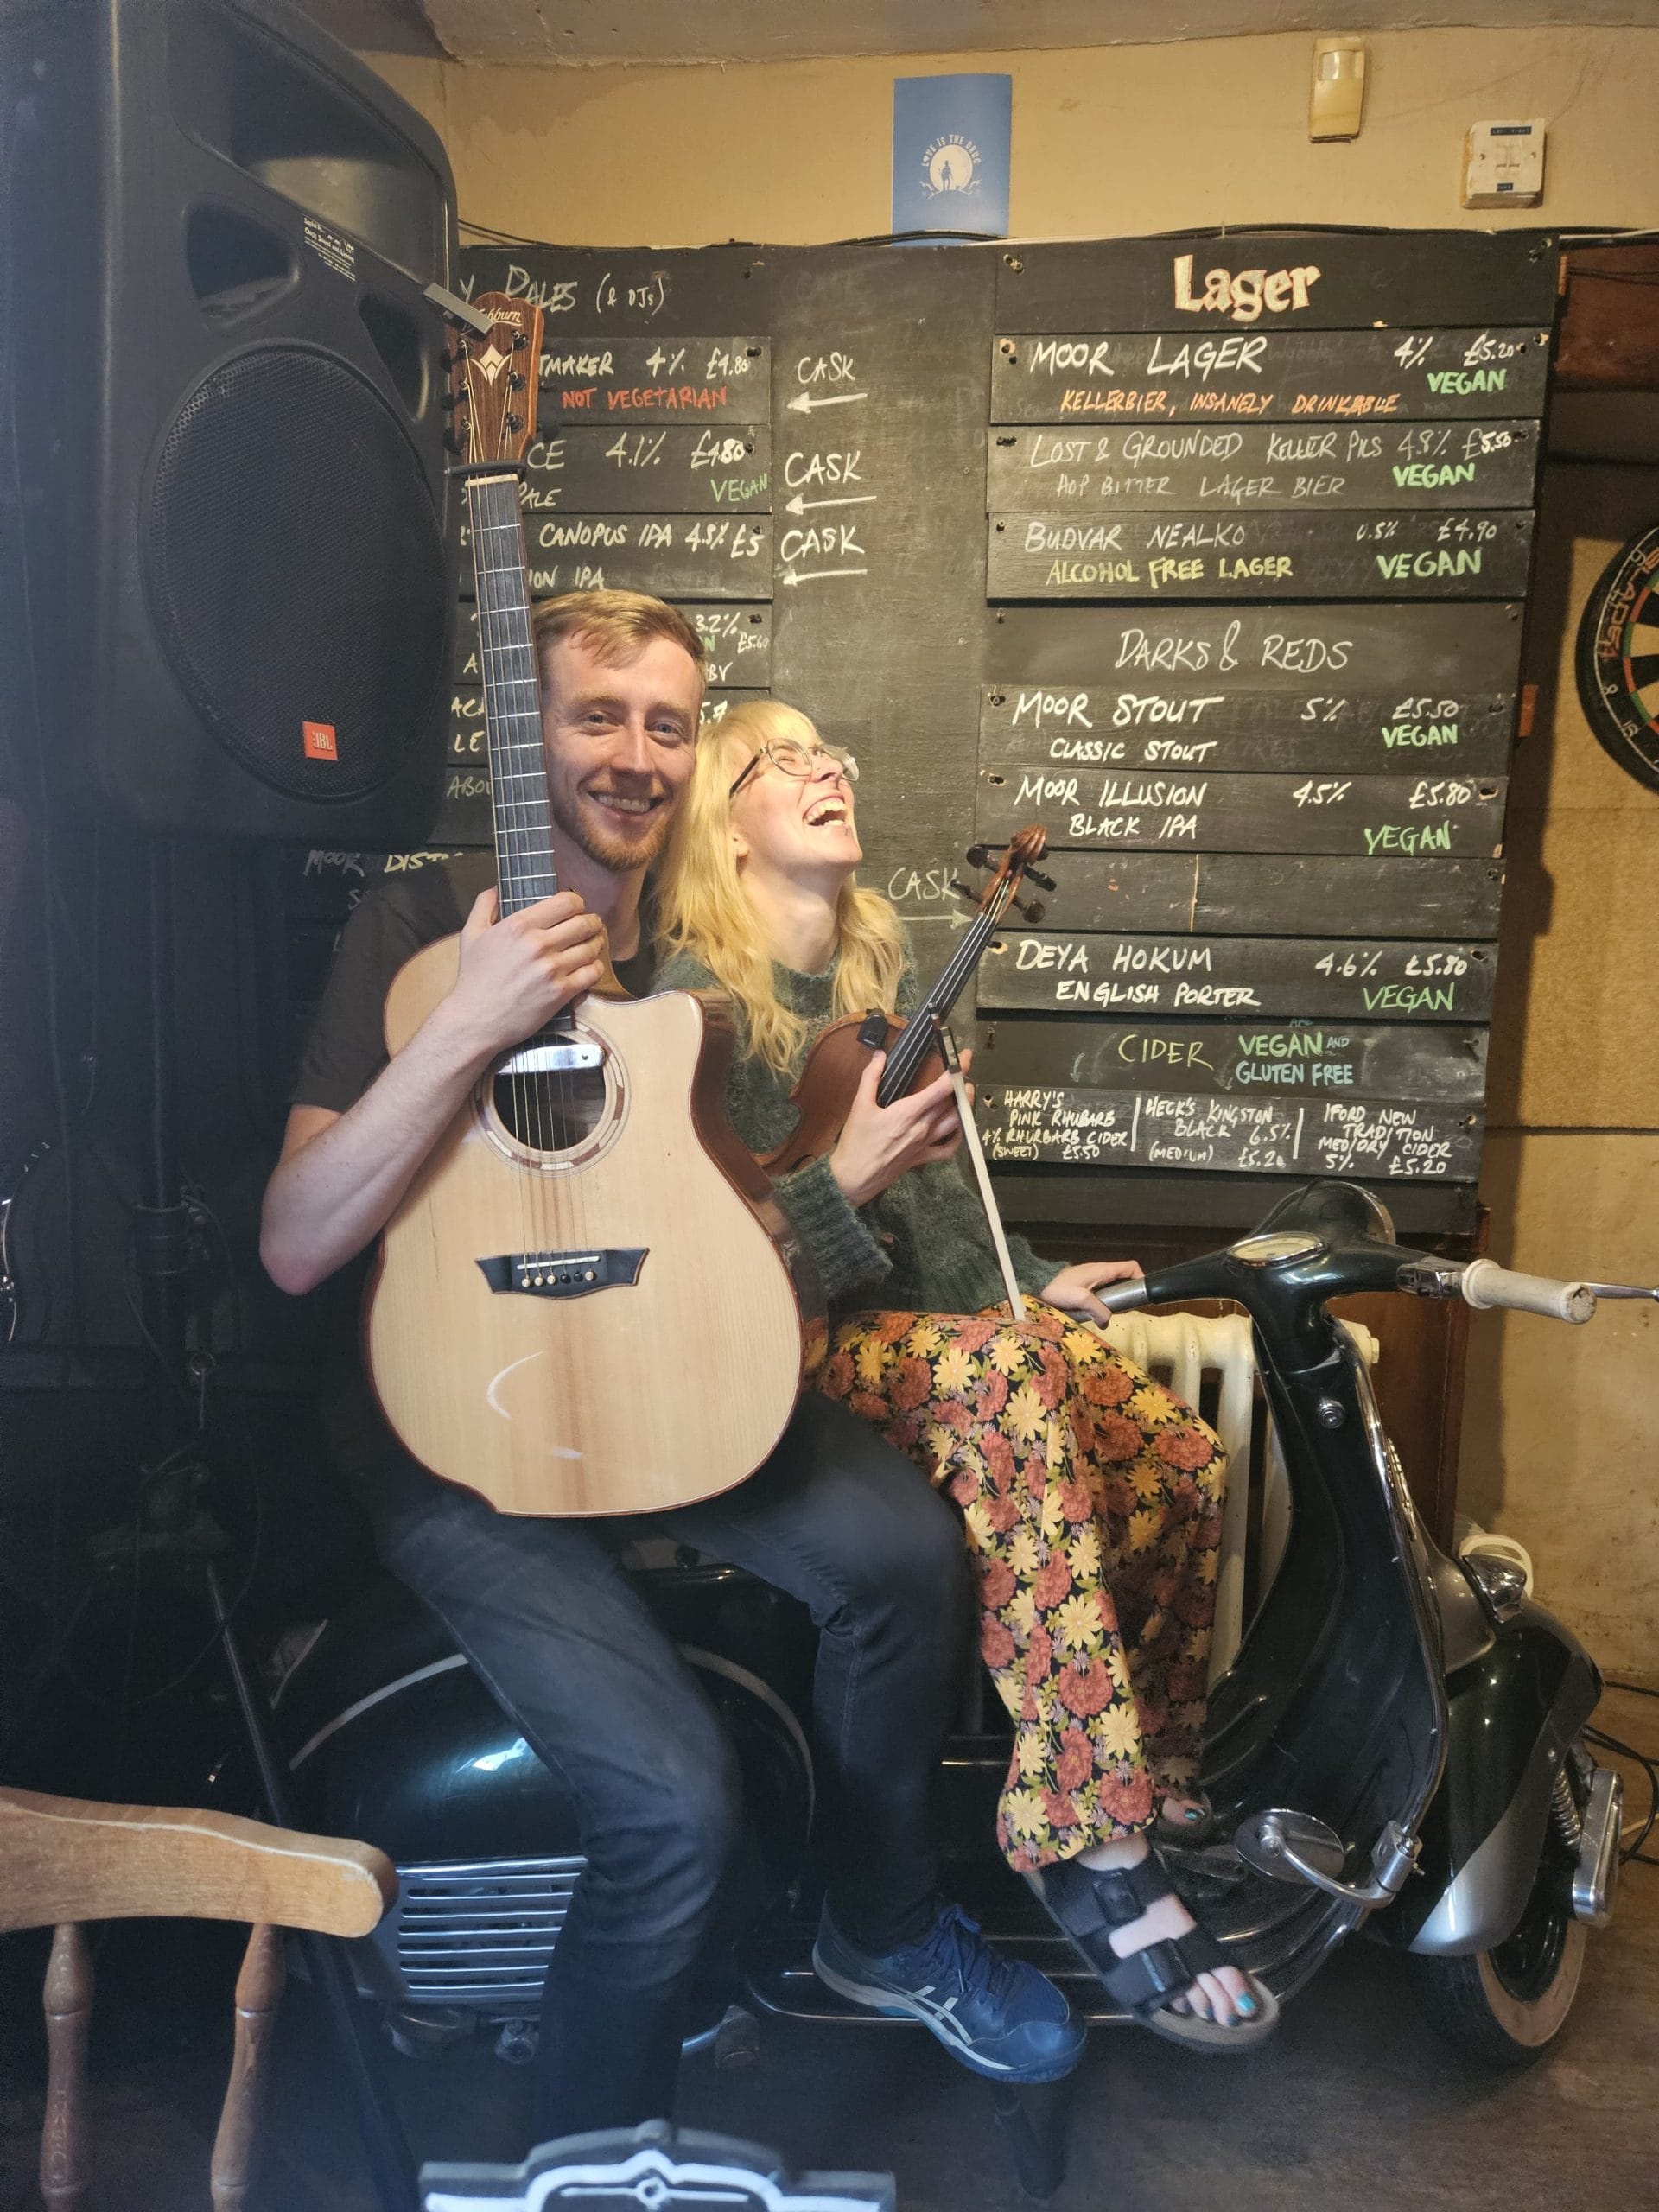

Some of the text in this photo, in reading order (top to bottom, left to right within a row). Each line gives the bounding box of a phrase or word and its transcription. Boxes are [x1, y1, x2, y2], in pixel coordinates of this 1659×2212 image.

[937, 136, 946, 147] IS
[949, 134, 965, 145] THE
[966, 141, 982, 164] DRUG
[1173, 254, 1322, 322] Lager
[478, 307, 523, 323] hburn
[645, 346, 685, 378] 4%
[798, 351, 856, 384] CASK
[1030, 340, 1115, 377] MOOR
[1147, 335, 1268, 382] LAGER
[1394, 335, 1433, 370] 4%
[1427, 368, 1507, 395] VEGAN
[563, 385, 728, 410] NOT VEGETARIAN
[1189, 391, 1274, 416] INSANELY
[1030, 435, 1092, 467] LOST
[1095, 437, 1110, 462] &
[1122, 429, 1243, 469] GROUNDED
[1266, 431, 1337, 464] KELLER
[1397, 429, 1452, 461] 4.8%
[785, 450, 862, 487] CASK
[1392, 462, 1476, 489] VEGAN
[710, 473, 768, 503] VEGAN
[1199, 474, 1282, 505] LAGER
[1291, 476, 1346, 499] BIER
[539, 521, 628, 548] CANOPUS
[638, 523, 672, 548] IPA
[730, 524, 765, 558] £5
[780, 524, 865, 562] CASK
[1024, 522, 1122, 552] BUDVAR
[1147, 522, 1245, 550] NEALKO
[1436, 517, 1497, 543] £4.90
[575, 565, 606, 591] IPA
[1046, 556, 1294, 589] ALCOHOL FREE LAGER
[1376, 549, 1482, 580] VEGAN
[1115, 620, 1353, 673] DARKS & REDS
[1012, 692, 1459, 728] MOOR STOUT 5% £5.50
[314, 732, 334, 750] JBL
[1049, 737, 1217, 763] CLASSIC STOUT
[1382, 723, 1459, 748] VEGAN
[1014, 775, 1471, 809] MOOR ILLUSION 4.5% £5.80
[1069, 812, 1198, 840] BLACK IPA
[1363, 819, 1452, 856] VEGAN
[888, 867, 962, 901] CASK
[1015, 939, 1089, 974] DEYA
[1112, 944, 1212, 973] HOKUM
[1315, 950, 1383, 977] 4.6%
[1055, 980, 1262, 1007] ENGLISH PORTER
[1363, 981, 1455, 1014] VEGAN
[1118, 1033, 1215, 1071] CIDER
[1238, 1031, 1350, 1058] VEGAN AND
[1235, 1060, 1354, 1086] GLUTEN FREE
[1004, 1090, 1065, 1111] HARRY'S
[1206, 1098, 1274, 1128] KINGSTON
[1009, 1109, 1116, 1128] PINK RHUBARB
[1173, 1117, 1291, 1146] BLACK 6.5%
[1379, 1109, 1416, 1126] NEW
[1086, 1131, 1128, 1147] CIDER
[1402, 1141, 1452, 1159] CIDER
[1325, 1154, 1446, 1175] 5% £5.20
